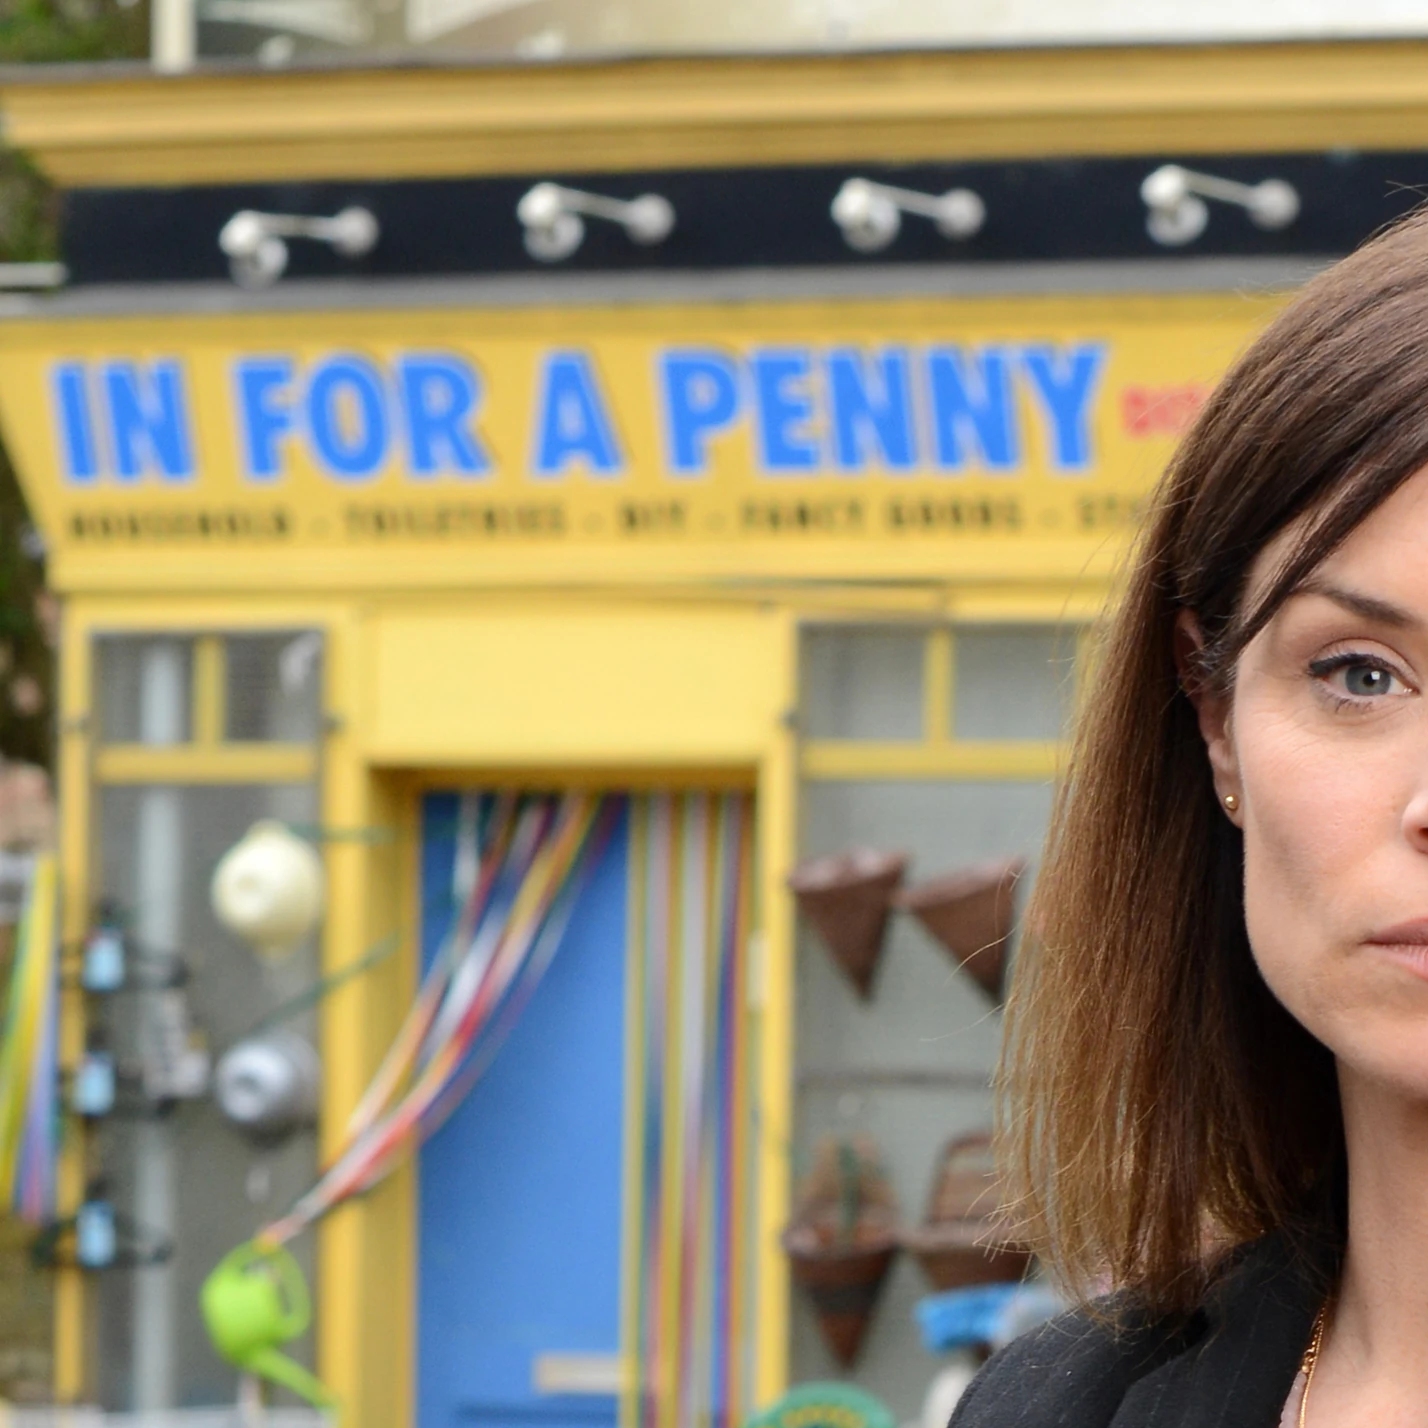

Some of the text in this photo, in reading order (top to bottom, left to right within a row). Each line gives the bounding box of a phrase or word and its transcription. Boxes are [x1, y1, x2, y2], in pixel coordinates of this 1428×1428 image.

[53, 357, 197, 483] IN
[232, 351, 494, 482] FOR
[530, 348, 628, 478] A
[654, 340, 1109, 475] PENNY
